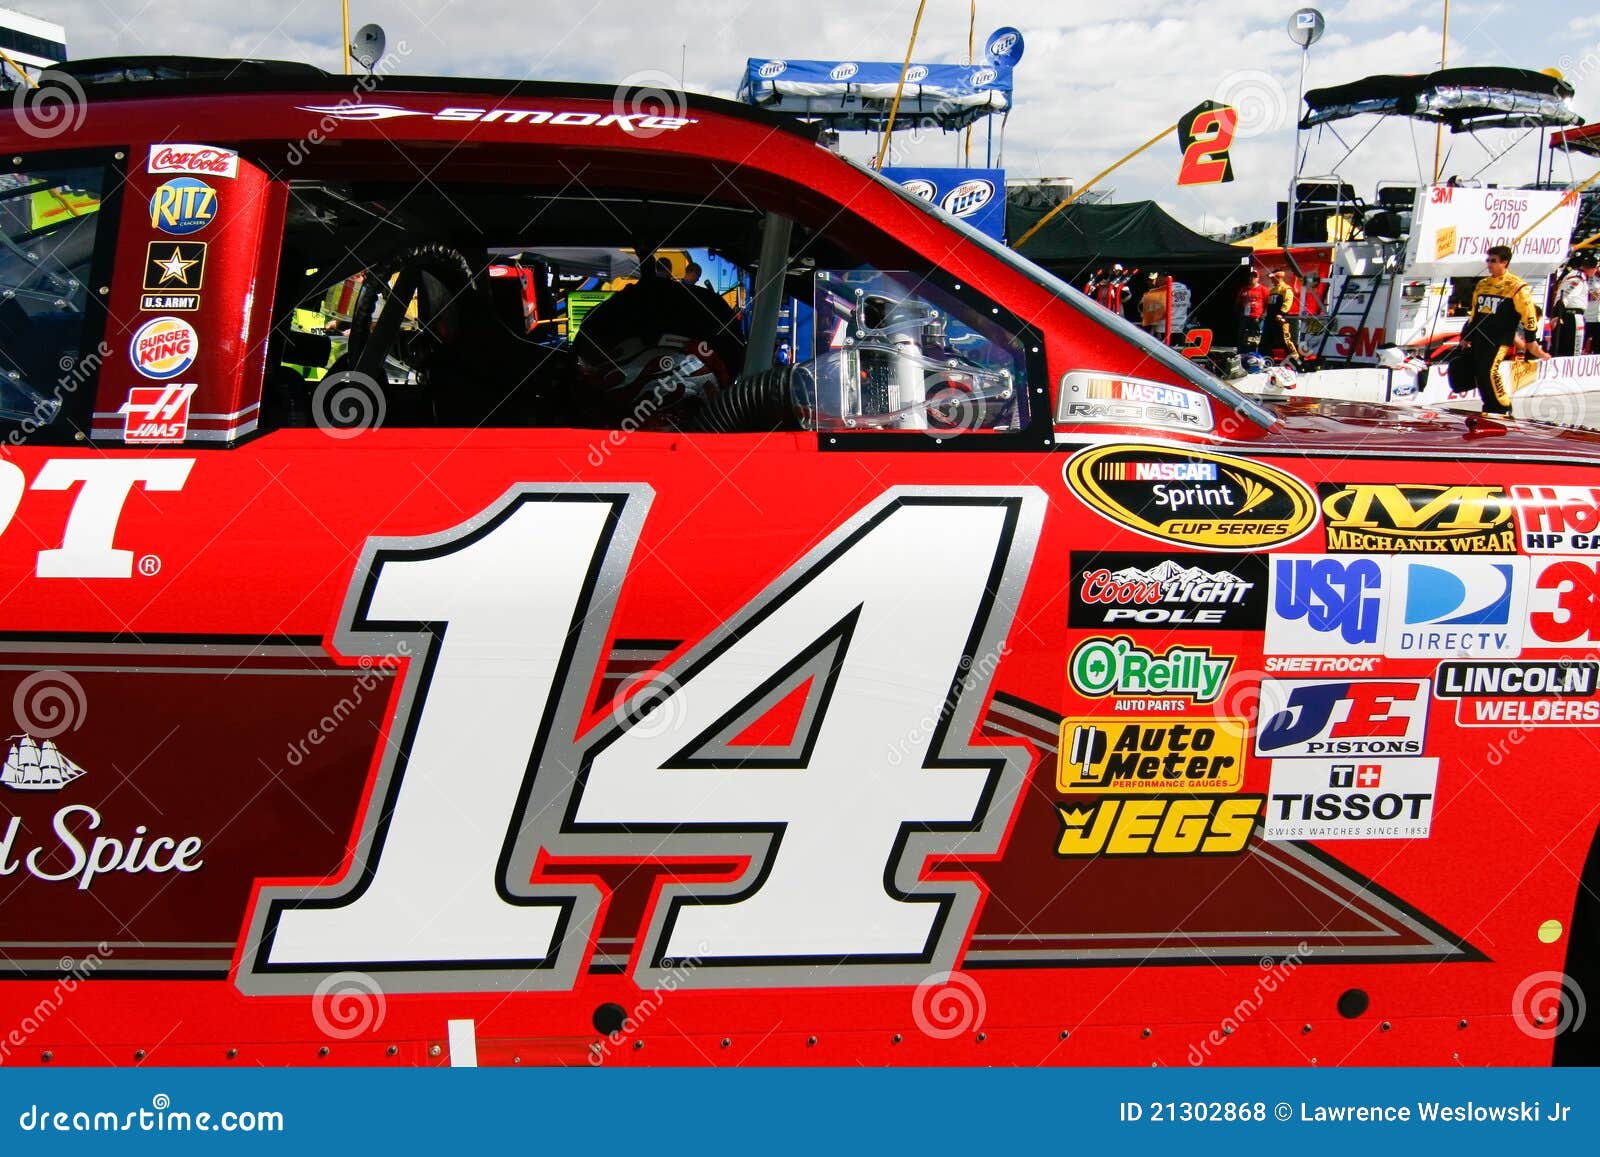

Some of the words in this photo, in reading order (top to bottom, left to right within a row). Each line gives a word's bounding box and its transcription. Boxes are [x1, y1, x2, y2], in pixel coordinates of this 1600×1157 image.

[1177, 107, 1239, 186] 2
[152, 147, 229, 173] Coca-Cola
[151, 185, 217, 229] RITZ
[1431, 187, 1454, 205] 3M
[1485, 193, 1528, 212] Census
[1489, 212, 1520, 230] 2010
[1525, 237, 1562, 255] HANDS
[139, 329, 190, 351] BURGER
[1336, 326, 1386, 357] 3M
[139, 339, 192, 367] KING
[1121, 382, 1186, 407] NASCAR
[1067, 402, 1142, 418] RACE
[1146, 406, 1201, 424] CAR
[131, 423, 185, 437] HAAS
[1136, 463, 1213, 480] NASCAR
[1153, 484, 1234, 512] Sprint
[1168, 523, 1212, 535] CUP
[1215, 523, 1289, 535] SERIES
[1326, 526, 1447, 552] MECHANIX
[1449, 528, 1517, 552] WEAR
[1526, 534, 1563, 549] HP
[1080, 568, 1164, 605] Coors
[1164, 581, 1255, 604] LIGHT
[1274, 558, 1382, 645] USG
[1103, 609, 1227, 624] POLE
[1400, 632, 1508, 650] DIRECTV
[1076, 642, 1225, 697] O'Reilly
[1264, 657, 1376, 672] SHEETROCK
[1445, 667, 1590, 693] LINCOLN
[1115, 700, 1146, 711] AUTO
[1147, 700, 1185, 711] PARTS
[1258, 681, 1421, 752] JE
[1475, 701, 1600, 721] WELDERS
[252, 486, 1032, 976] 14
[1113, 724, 1216, 752] Auto
[1307, 741, 1420, 754] PISTONS
[1104, 752, 1236, 781] Meter
[1112, 780, 1185, 789] PERFORMANCE
[1188, 780, 1228, 788] GAUGES
[1272, 793, 1432, 821] TISSOT
[1058, 799, 1263, 854] JEGS
[1268, 828, 1304, 836] SWISS
[1309, 828, 1361, 836] WATCHES
[1366, 827, 1399, 835] SINCE
[1404, 827, 1428, 835] 1853
[26, 804, 204, 890] Spice
